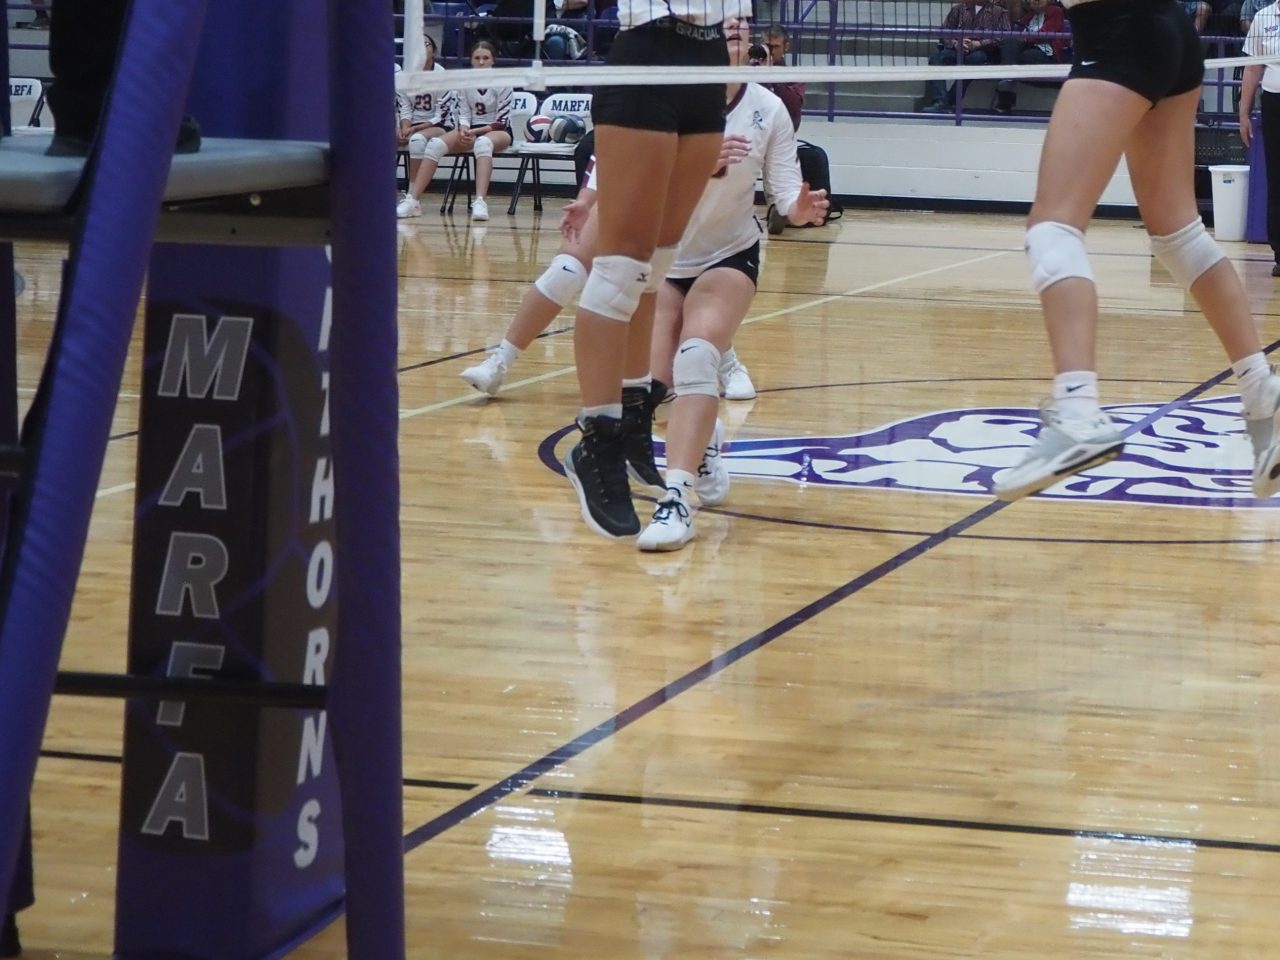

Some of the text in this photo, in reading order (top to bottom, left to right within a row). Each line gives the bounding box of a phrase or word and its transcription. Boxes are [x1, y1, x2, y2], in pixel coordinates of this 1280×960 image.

[9, 85, 32, 96] RFA
[414, 94, 432, 112] 23
[474, 102, 488, 115] 3
[551, 99, 591, 112] MARFA
[141, 313, 254, 840] MARFA
